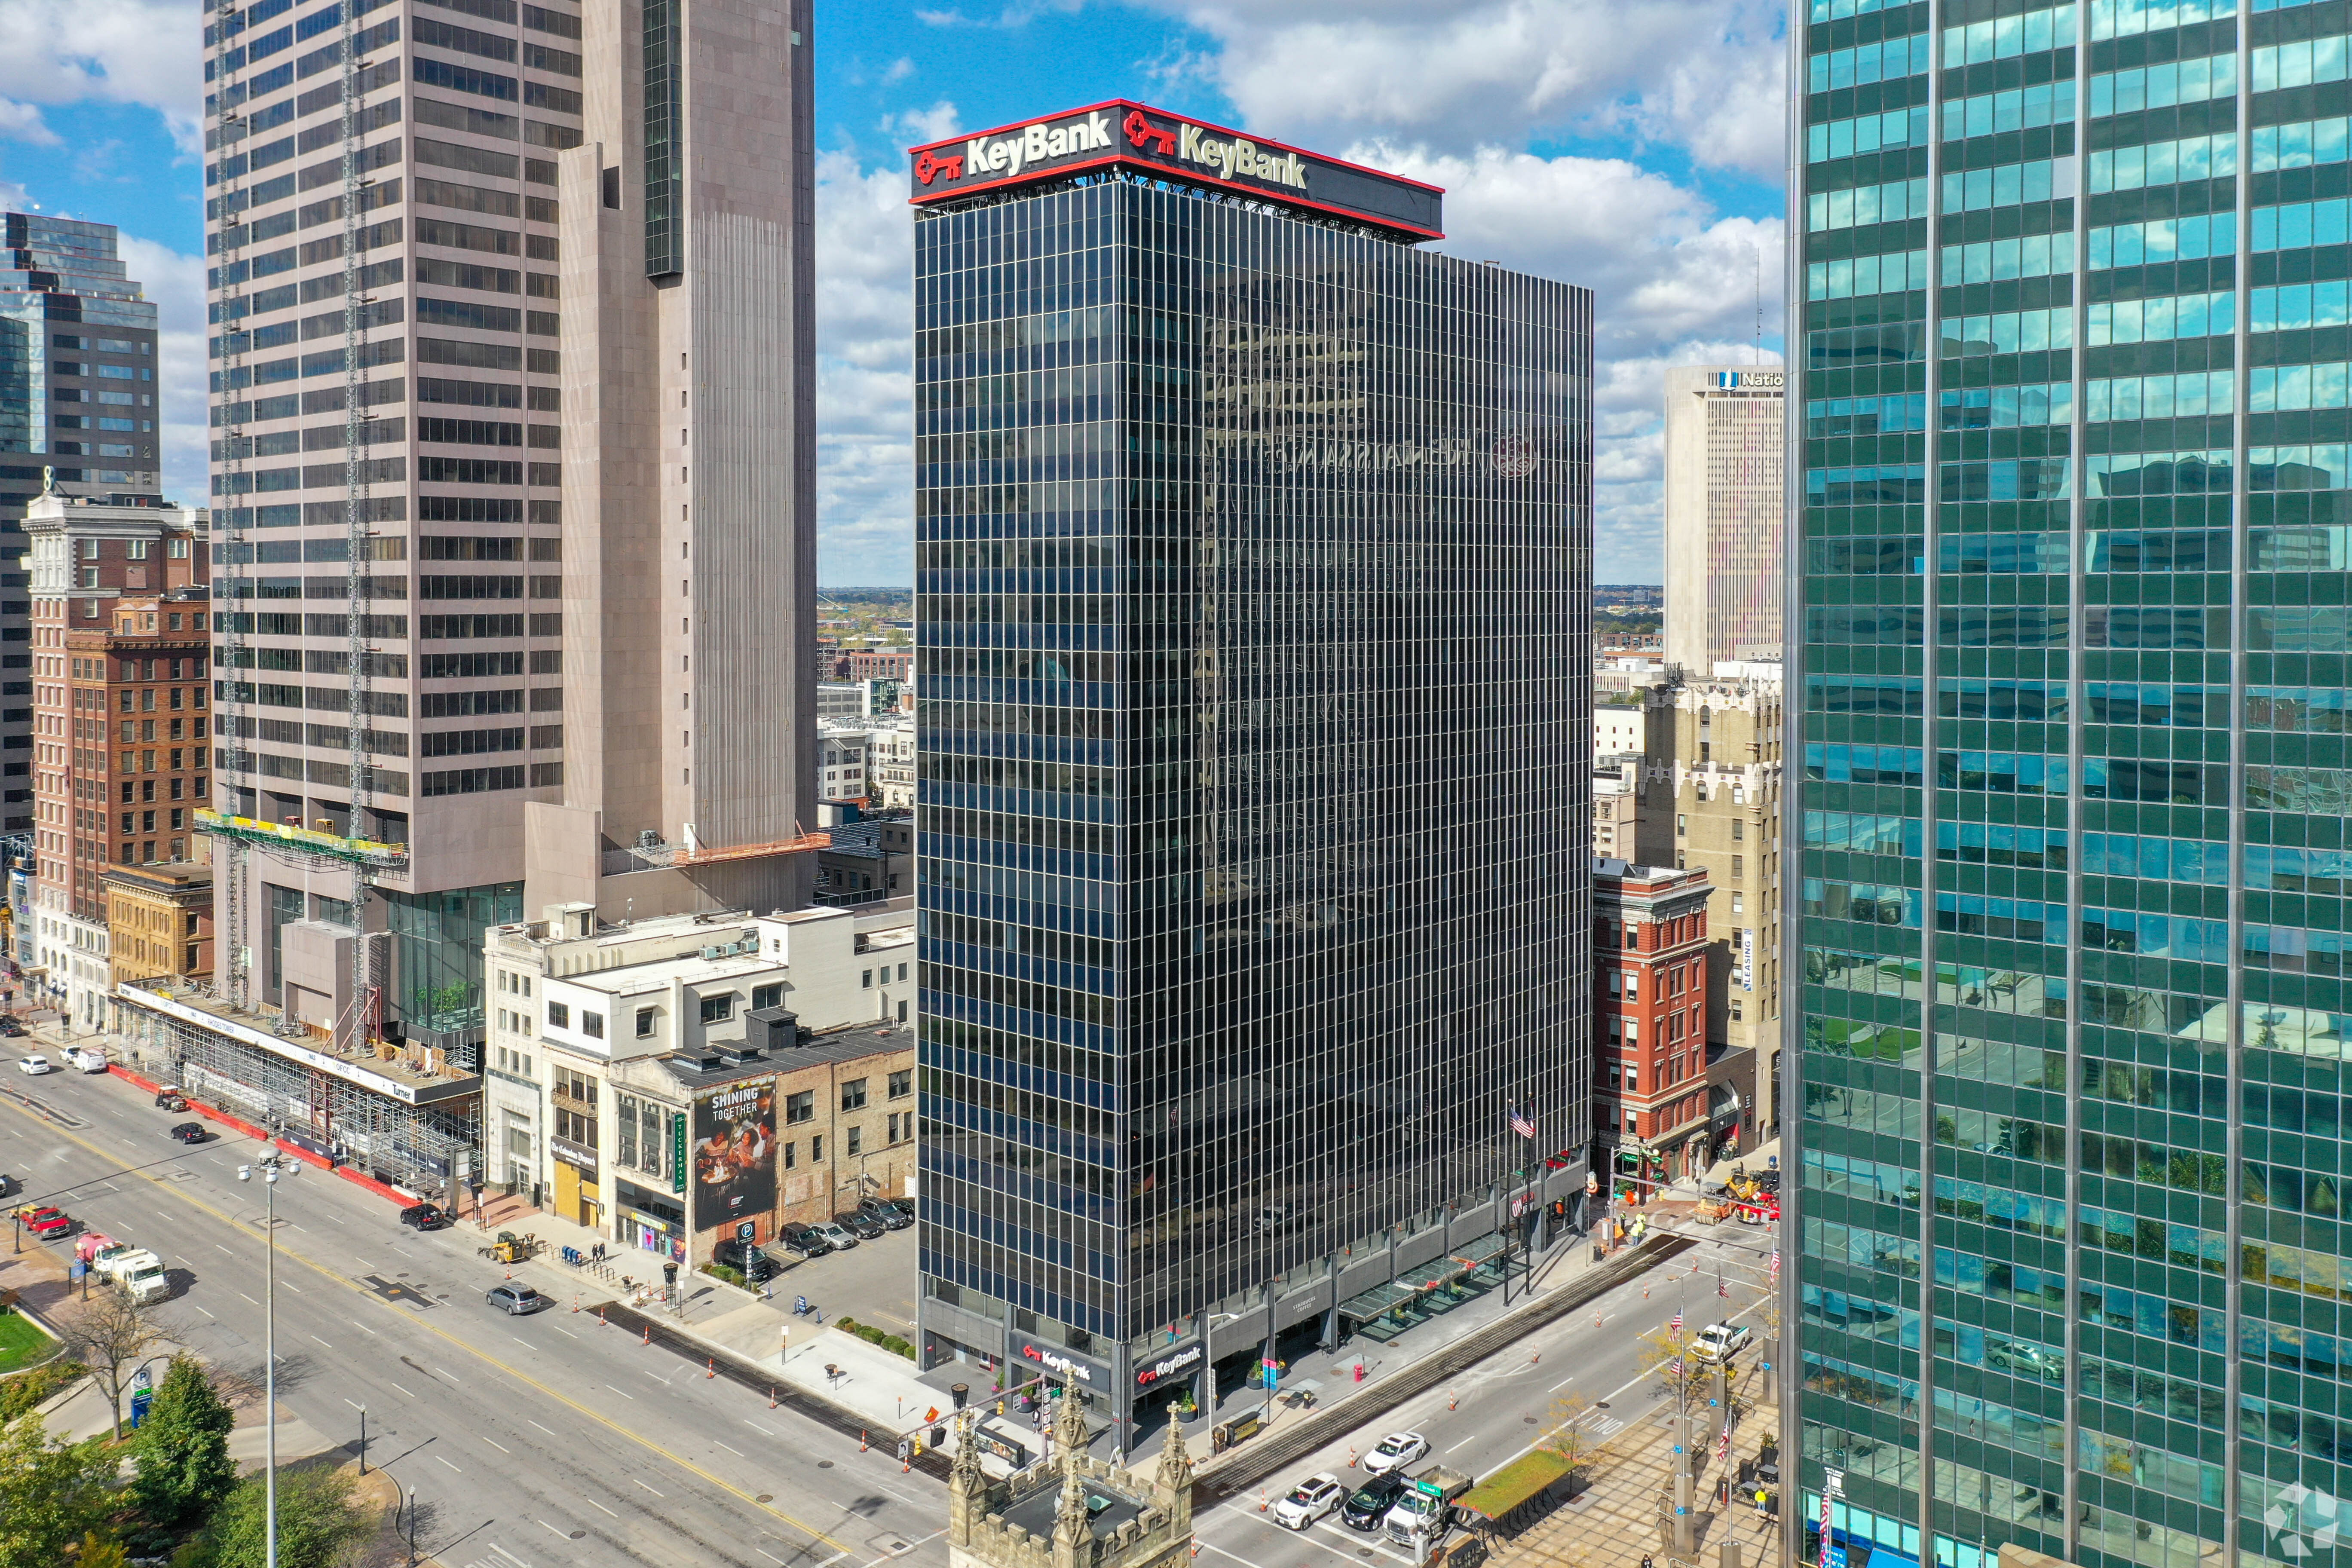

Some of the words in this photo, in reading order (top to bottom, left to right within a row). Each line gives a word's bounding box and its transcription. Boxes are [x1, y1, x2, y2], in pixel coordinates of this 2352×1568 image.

[968, 111, 1112, 176] KeyBank
[1181, 123, 1306, 189] KeyBank
[1743, 373, 1783, 386] Natio
[208, 1018, 222, 1029] RHODES
[223, 1024, 234, 1033] TOWER
[337, 1063, 350, 1074] OFCC
[392, 1084, 410, 1100] Turner
[712, 1087, 758, 1109] SHINING
[713, 1102, 757, 1121] TOGETHER
[559, 1145, 578, 1159] Columbus
[578, 1152, 595, 1166] Dispatch
[1512, 1199, 1522, 1217] OH
[1293, 1296, 1316, 1310] STARBUCKS
[1297, 1303, 1311, 1313] COFFEE
[1156, 1347, 1200, 1376] KeyBank
